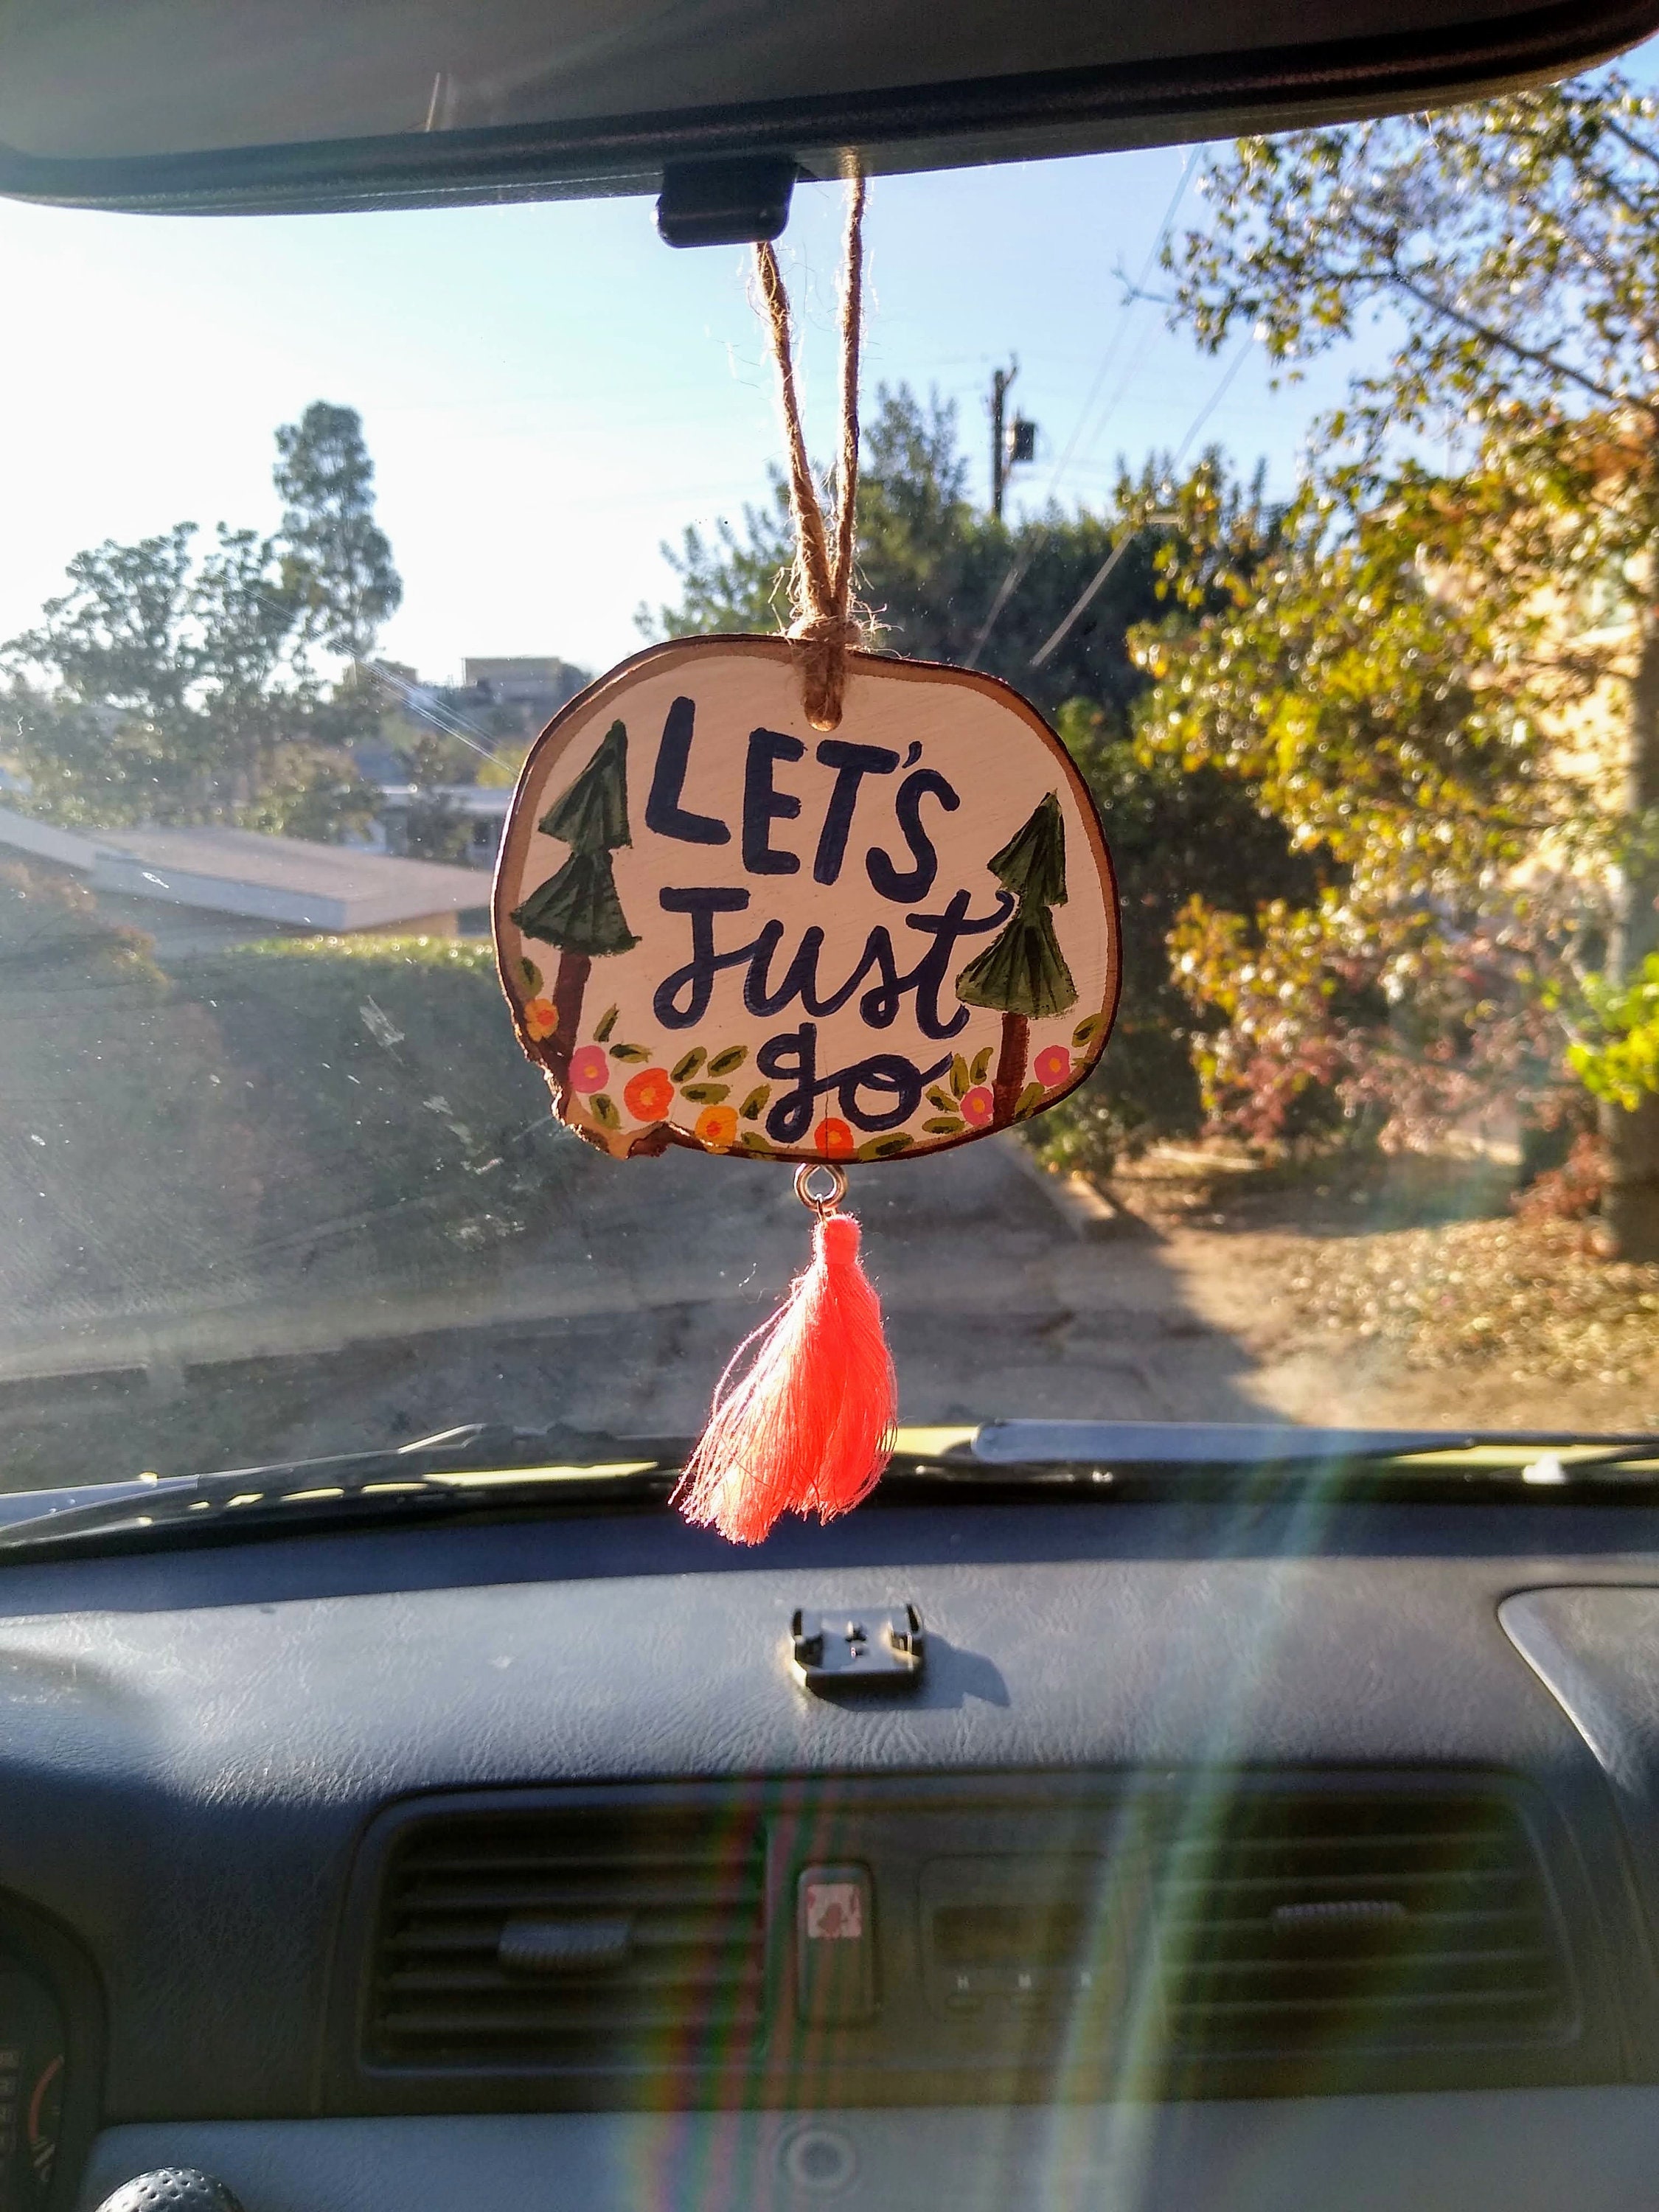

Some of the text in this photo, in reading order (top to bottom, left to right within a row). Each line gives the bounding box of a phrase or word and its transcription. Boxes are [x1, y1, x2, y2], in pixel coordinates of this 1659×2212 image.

[646, 697, 960, 903] LET'S
[653, 888, 1015, 1038] Just
[757, 1023, 953, 1143] go
